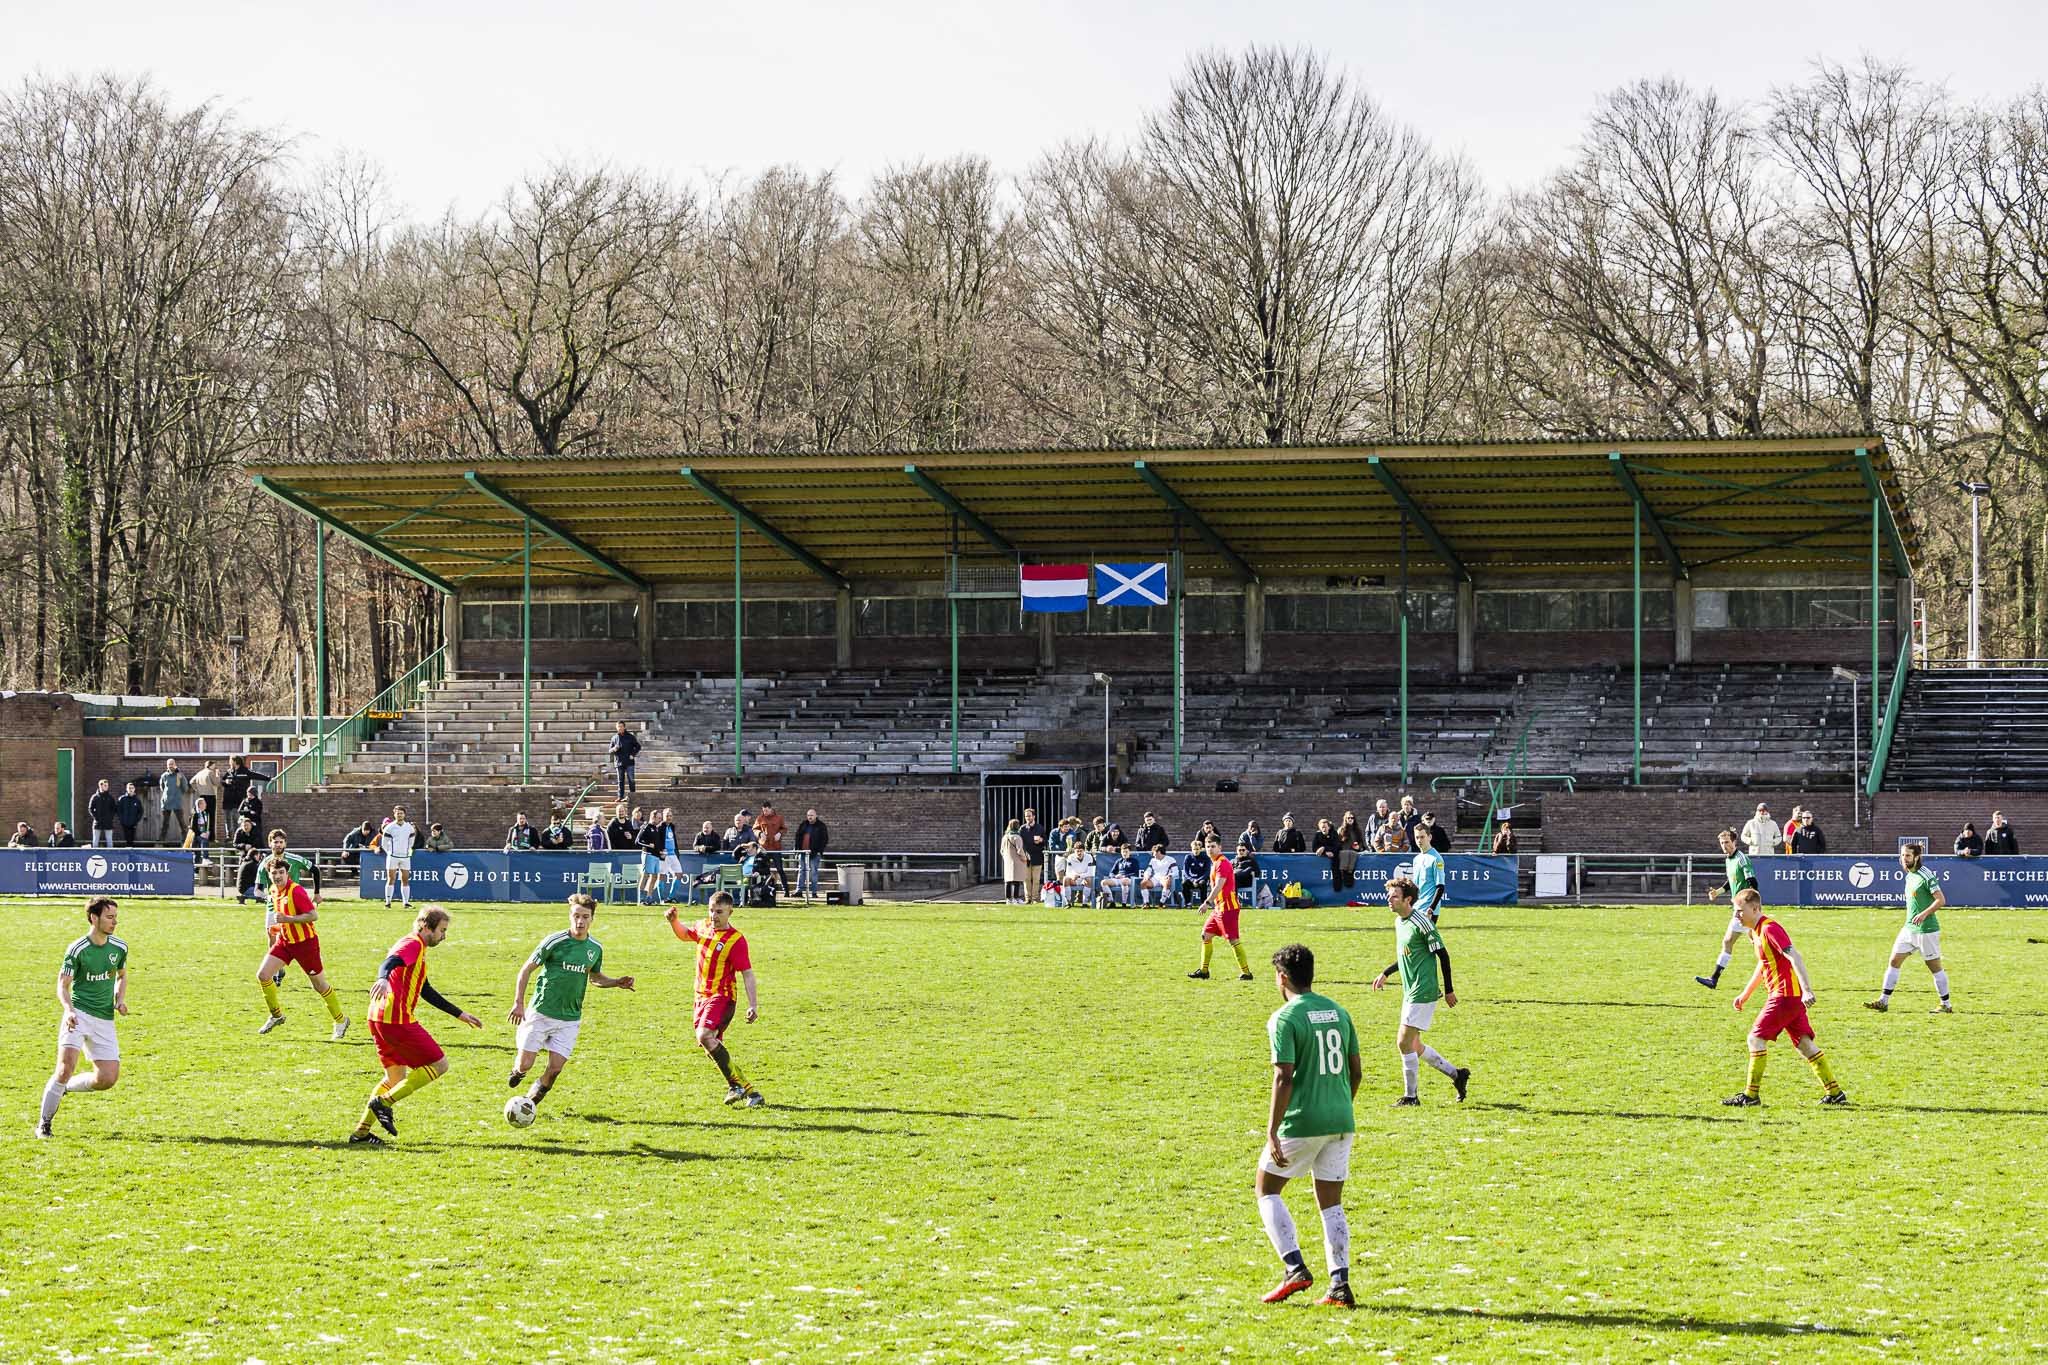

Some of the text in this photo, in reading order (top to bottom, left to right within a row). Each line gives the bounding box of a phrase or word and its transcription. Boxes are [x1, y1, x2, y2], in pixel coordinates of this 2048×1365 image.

[24, 862, 170, 873] FLETCHER FOOTBALL
[473, 871, 542, 883] HOTELS
[1774, 870, 1844, 881] FLETCHER
[1983, 870, 2048, 881] FLETCHE
[39, 882, 155, 891] WWW.FLETCHERFOOTBALL.NL
[1315, 1028, 1344, 1075] 18
